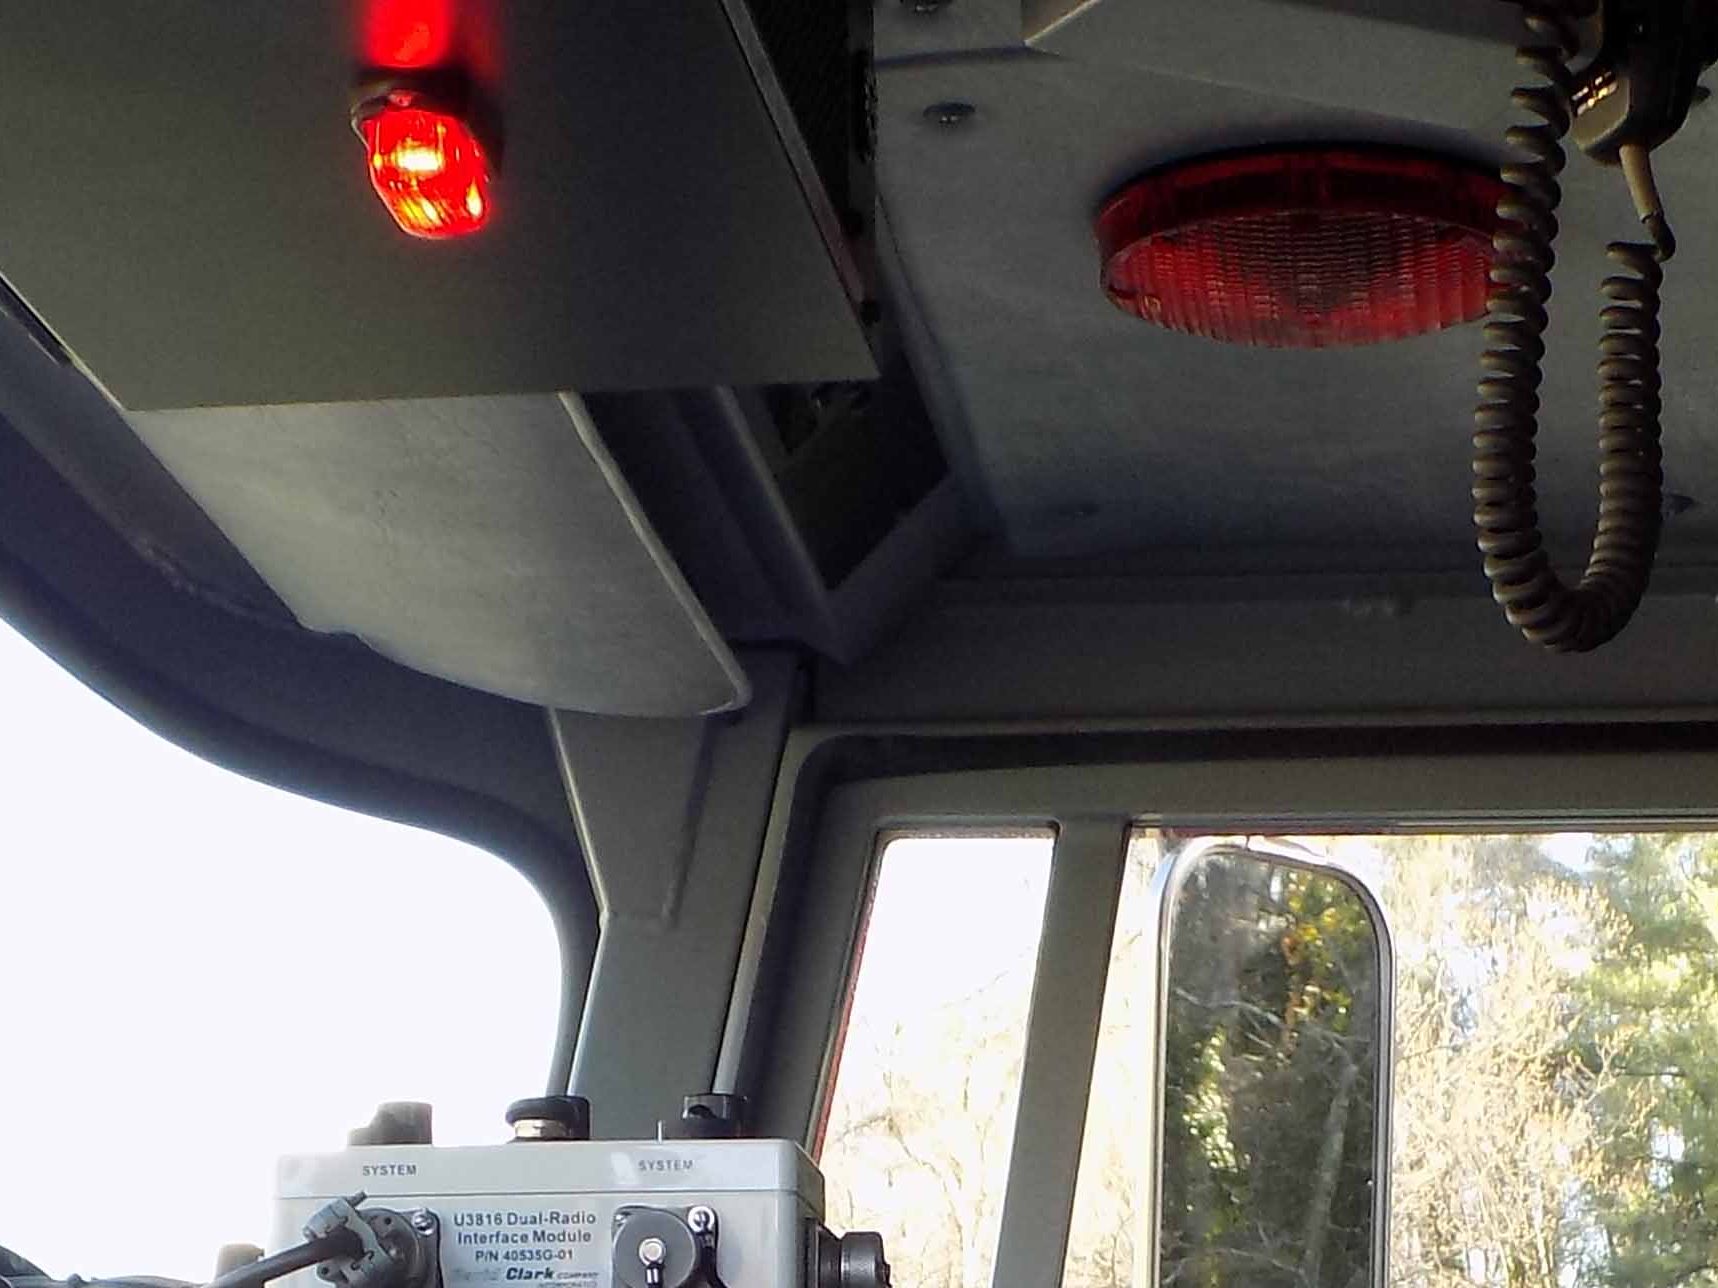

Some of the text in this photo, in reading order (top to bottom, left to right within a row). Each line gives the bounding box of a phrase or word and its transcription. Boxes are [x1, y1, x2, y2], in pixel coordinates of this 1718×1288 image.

[362, 1164, 418, 1176] SYSTEM
[638, 1159, 694, 1172] SYSTEM
[454, 1210, 597, 1227] U3816 Dual-Radio
[458, 1229, 592, 1245] Interface Module
[474, 1250, 499, 1262] P/N
[506, 1267, 555, 1281] Clark
